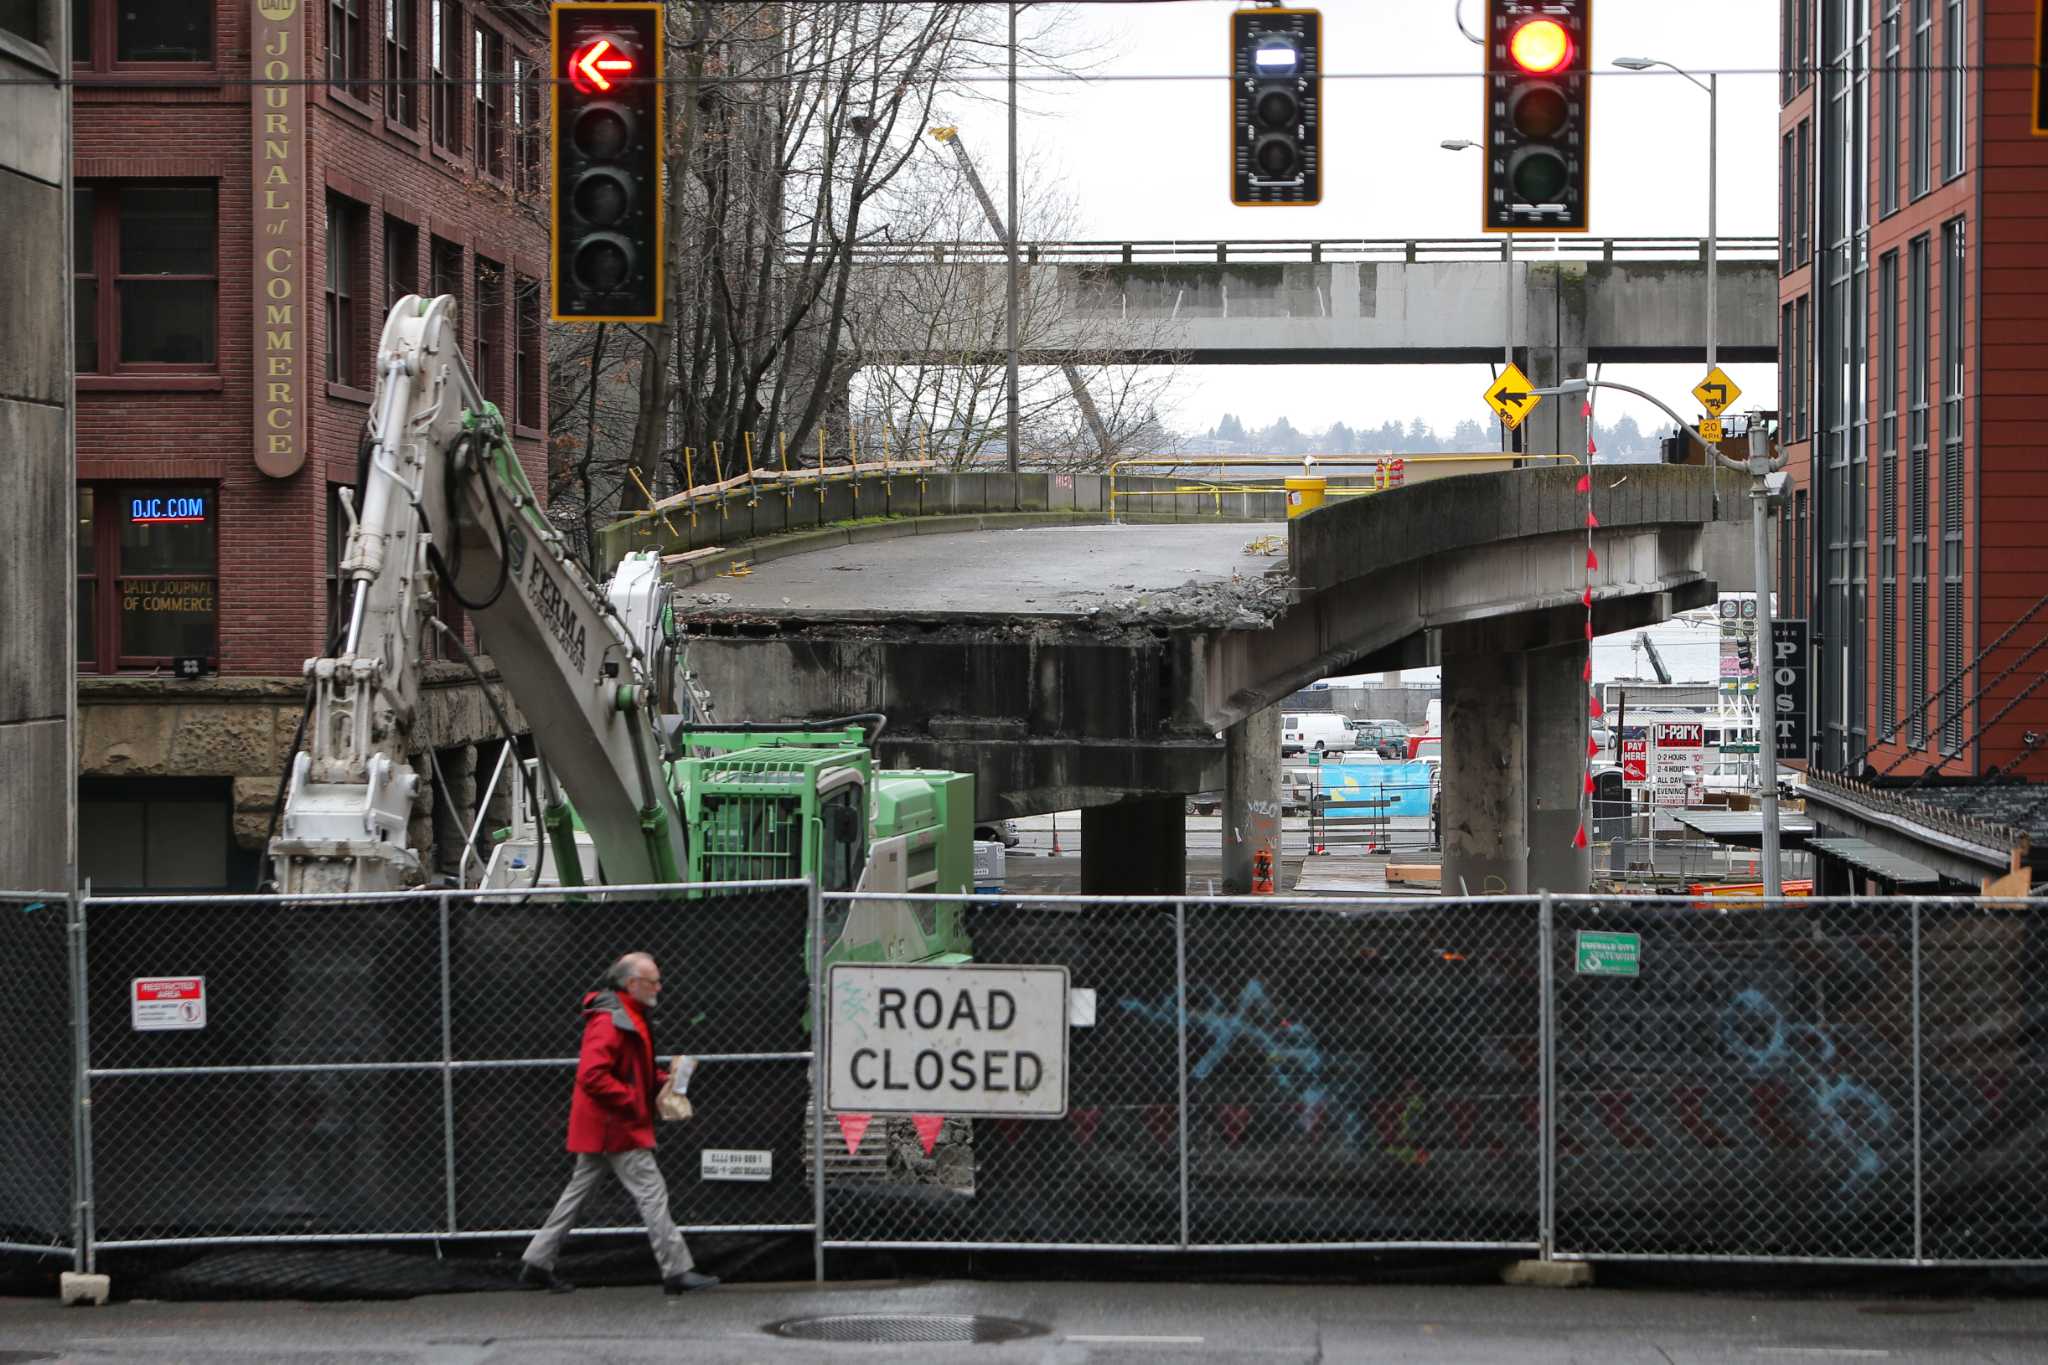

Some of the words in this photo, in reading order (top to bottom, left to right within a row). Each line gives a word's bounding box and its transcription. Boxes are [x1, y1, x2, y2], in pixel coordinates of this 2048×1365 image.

[264, 31, 290, 211] JOURNAL
[266, 218, 288, 236] of
[264, 246, 293, 456] COMMERCE
[1703, 422, 1718, 431] 20
[132, 498, 204, 518] DJC.COM
[123, 581, 158, 595] DAILY
[161, 580, 213, 595] JOURNAL
[123, 597, 141, 611] OF
[143, 597, 213, 612] COMMERCE
[528, 551, 587, 662] FERMA
[1774, 641, 1798, 738] POST
[1625, 751, 1646, 760] HERE
[1627, 742, 1643, 751] PAY
[1668, 753, 1687, 761] HOURS
[1668, 765, 1690, 773] HOUR
[878, 986, 1017, 1032] ROAD
[849, 1049, 1043, 1093] CLOSED
